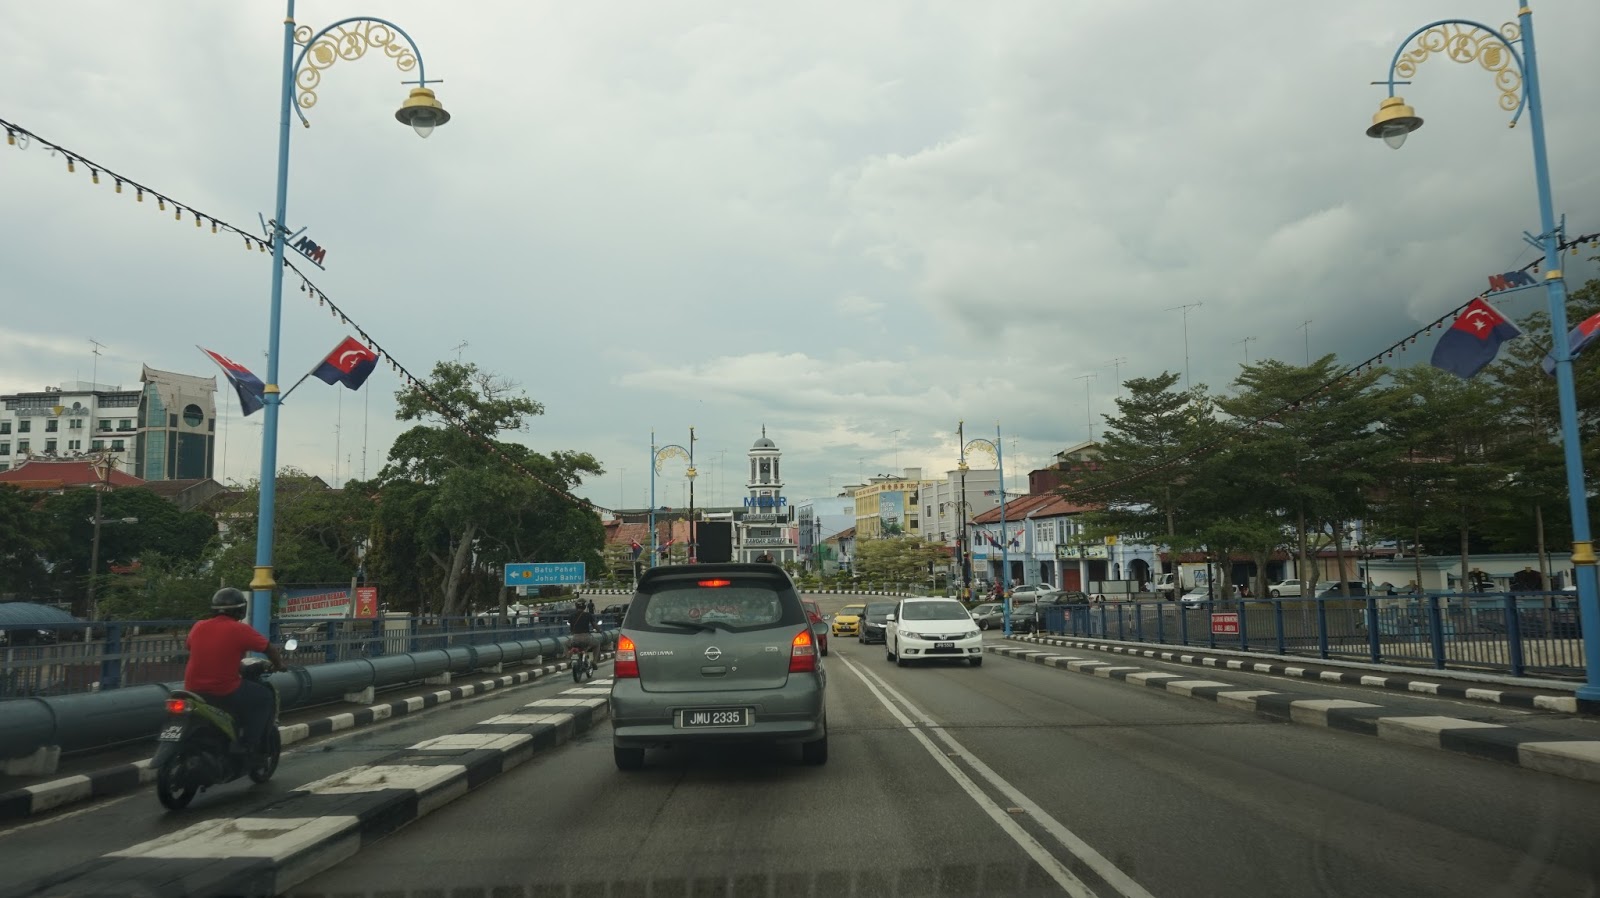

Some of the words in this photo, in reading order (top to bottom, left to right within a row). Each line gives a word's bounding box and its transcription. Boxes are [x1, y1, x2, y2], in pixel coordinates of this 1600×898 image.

[743, 496, 788, 507] MUAR
[690, 712, 710, 724] JMU
[713, 711, 740, 724] 2335
